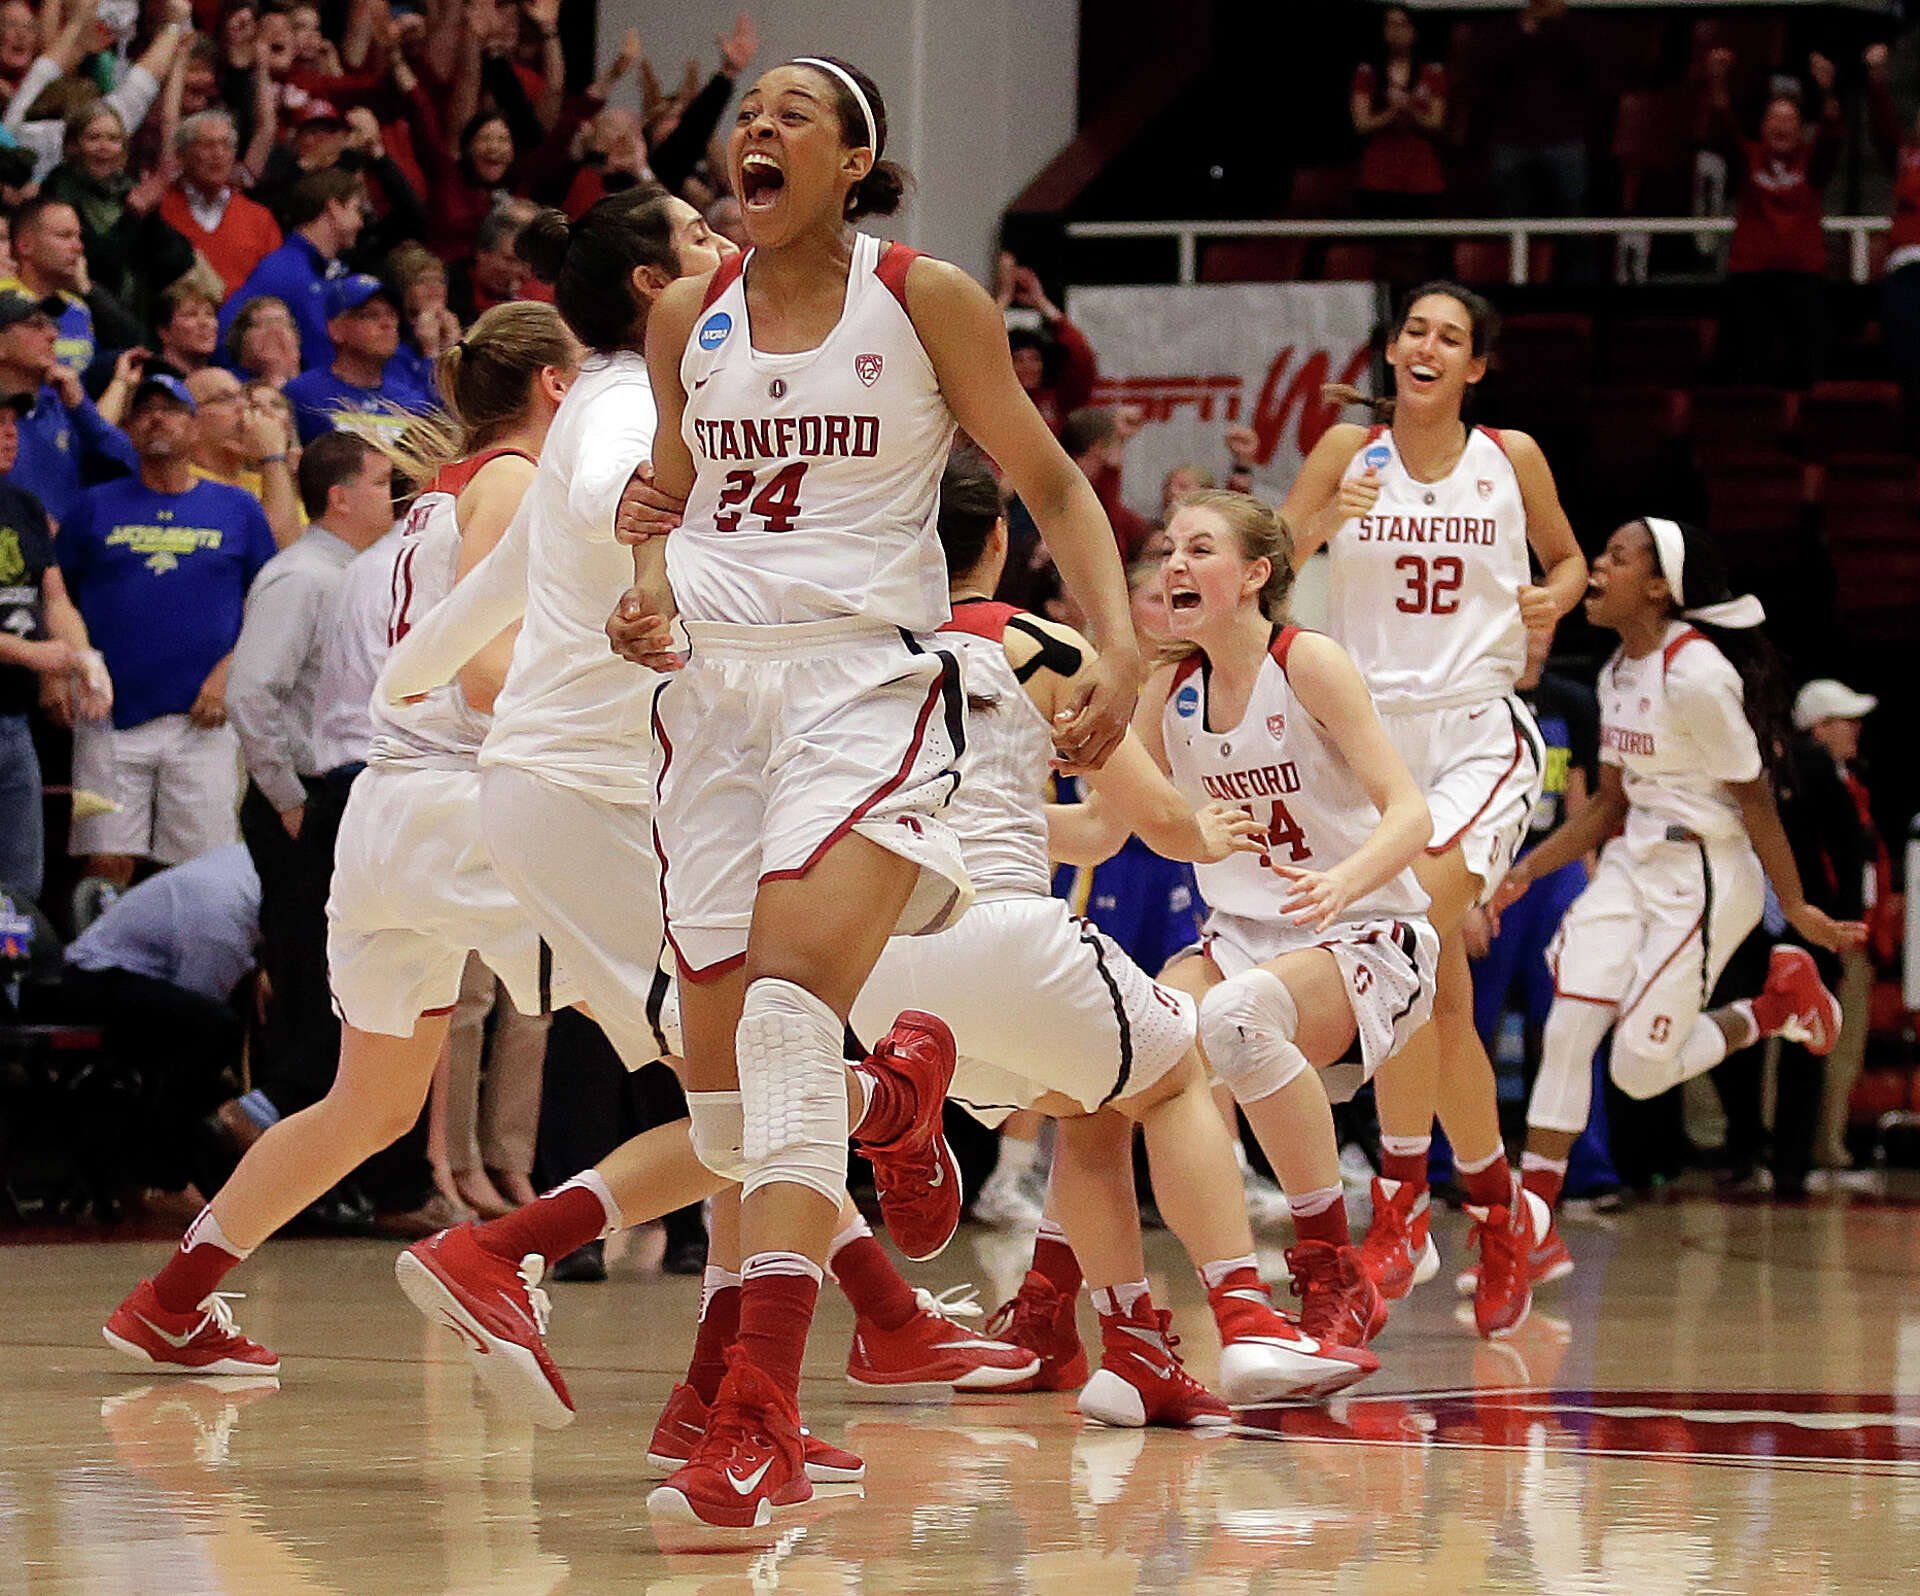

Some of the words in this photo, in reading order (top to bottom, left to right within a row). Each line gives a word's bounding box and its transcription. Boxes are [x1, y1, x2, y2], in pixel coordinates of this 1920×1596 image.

[694, 415, 881, 460] STANFORD
[713, 461, 810, 533] 24
[1358, 515, 1497, 547] STANFORD
[1395, 554, 1465, 615] 32
[1201, 761, 1301, 800] ANFORD
